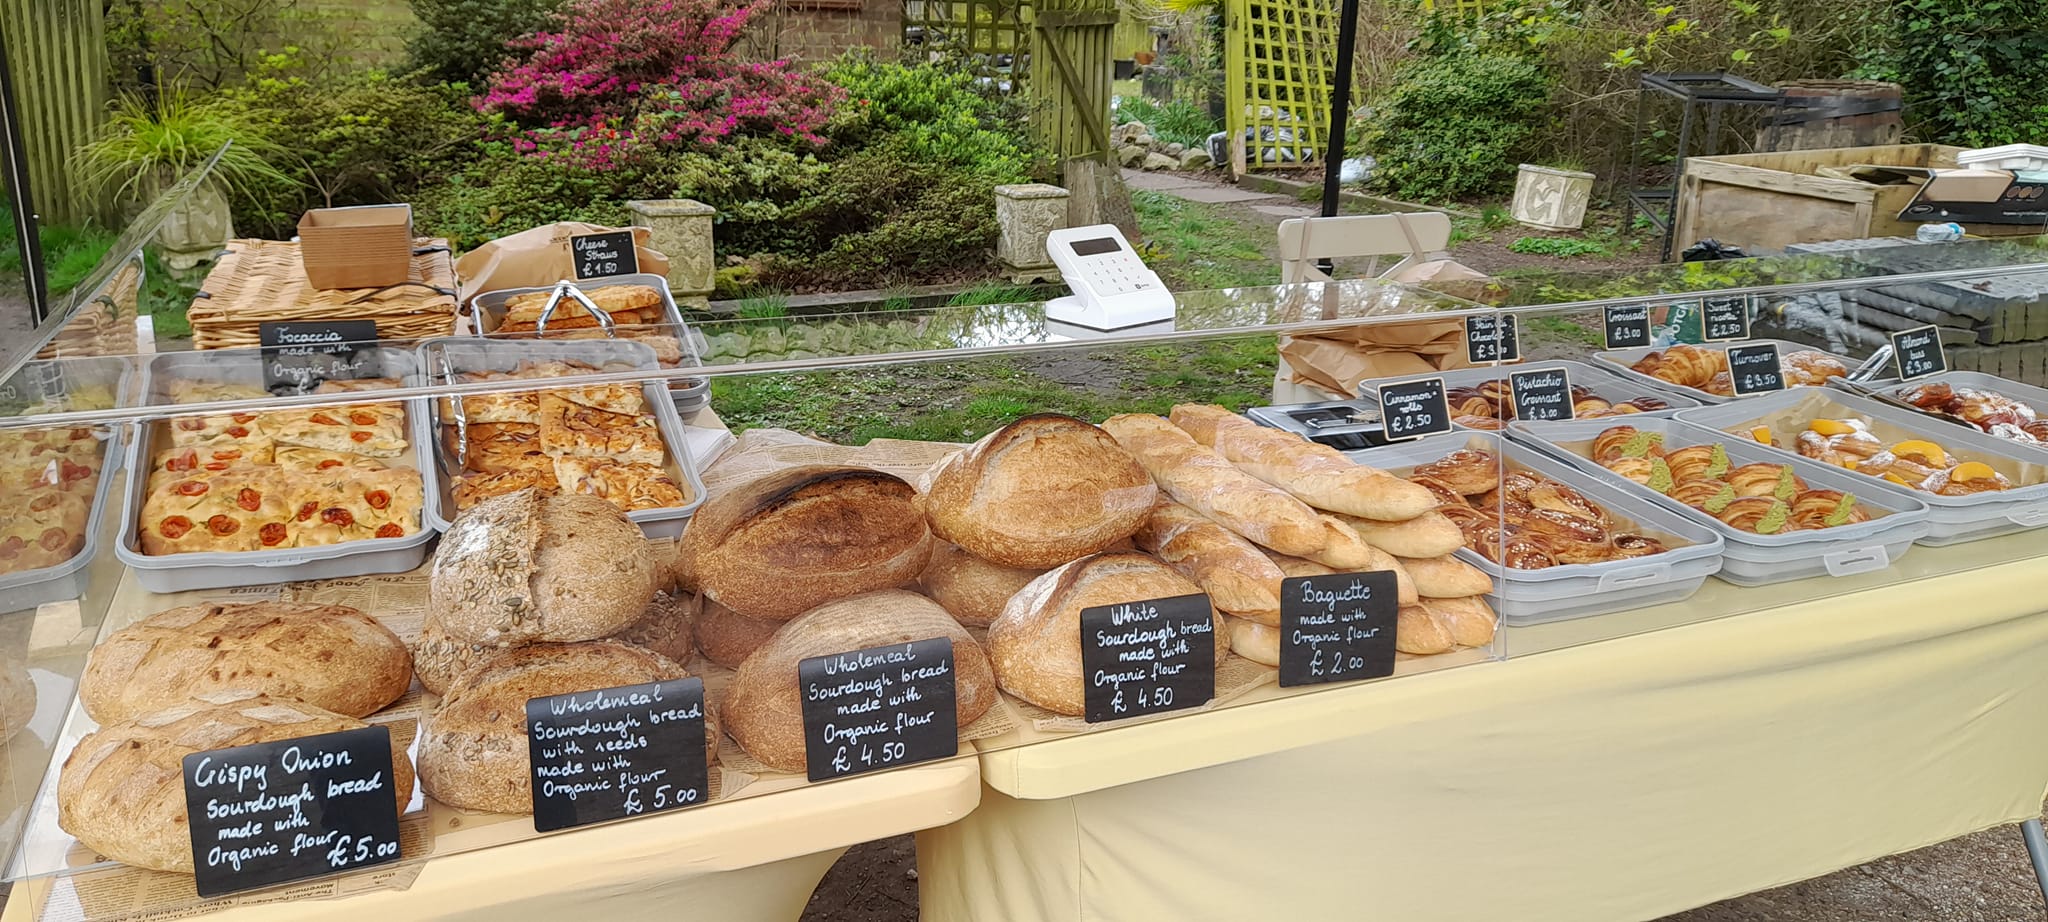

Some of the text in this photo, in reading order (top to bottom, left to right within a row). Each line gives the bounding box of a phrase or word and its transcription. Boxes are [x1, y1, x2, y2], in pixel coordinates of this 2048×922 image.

[276, 326, 342, 344] Focaccia
[280, 343, 352, 356] made with
[274, 360, 364, 380] Organic flour
[1383, 391, 1432, 406] Cinnamon
[1300, 578, 1371, 612] Baguette
[1111, 602, 1158, 626] White
[1300, 607, 1367, 625] made with
[1096, 618, 1212, 650] Sourdough bread
[1292, 625, 1380, 650] Organic flour
[823, 643, 916, 676] Wholemeal
[1119, 638, 1190, 662] made with
[808, 658, 950, 702] Sourdough bread
[1094, 662, 1186, 690] Organic flour
[550, 684, 663, 716] Wholemeal
[837, 686, 922, 716] made with
[534, 702, 702, 740] Sourdough bread
[824, 720, 889, 746] Organic
[894, 711, 935, 734] flour
[542, 734, 648, 760] with seeds
[194, 746, 353, 792] Crispy Onion
[537, 754, 632, 778] made with
[206, 771, 382, 820] Sourdough bread
[543, 768, 666, 800] Organic flour
[218, 814, 311, 841] made with
[208, 830, 338, 872] Organic flour
